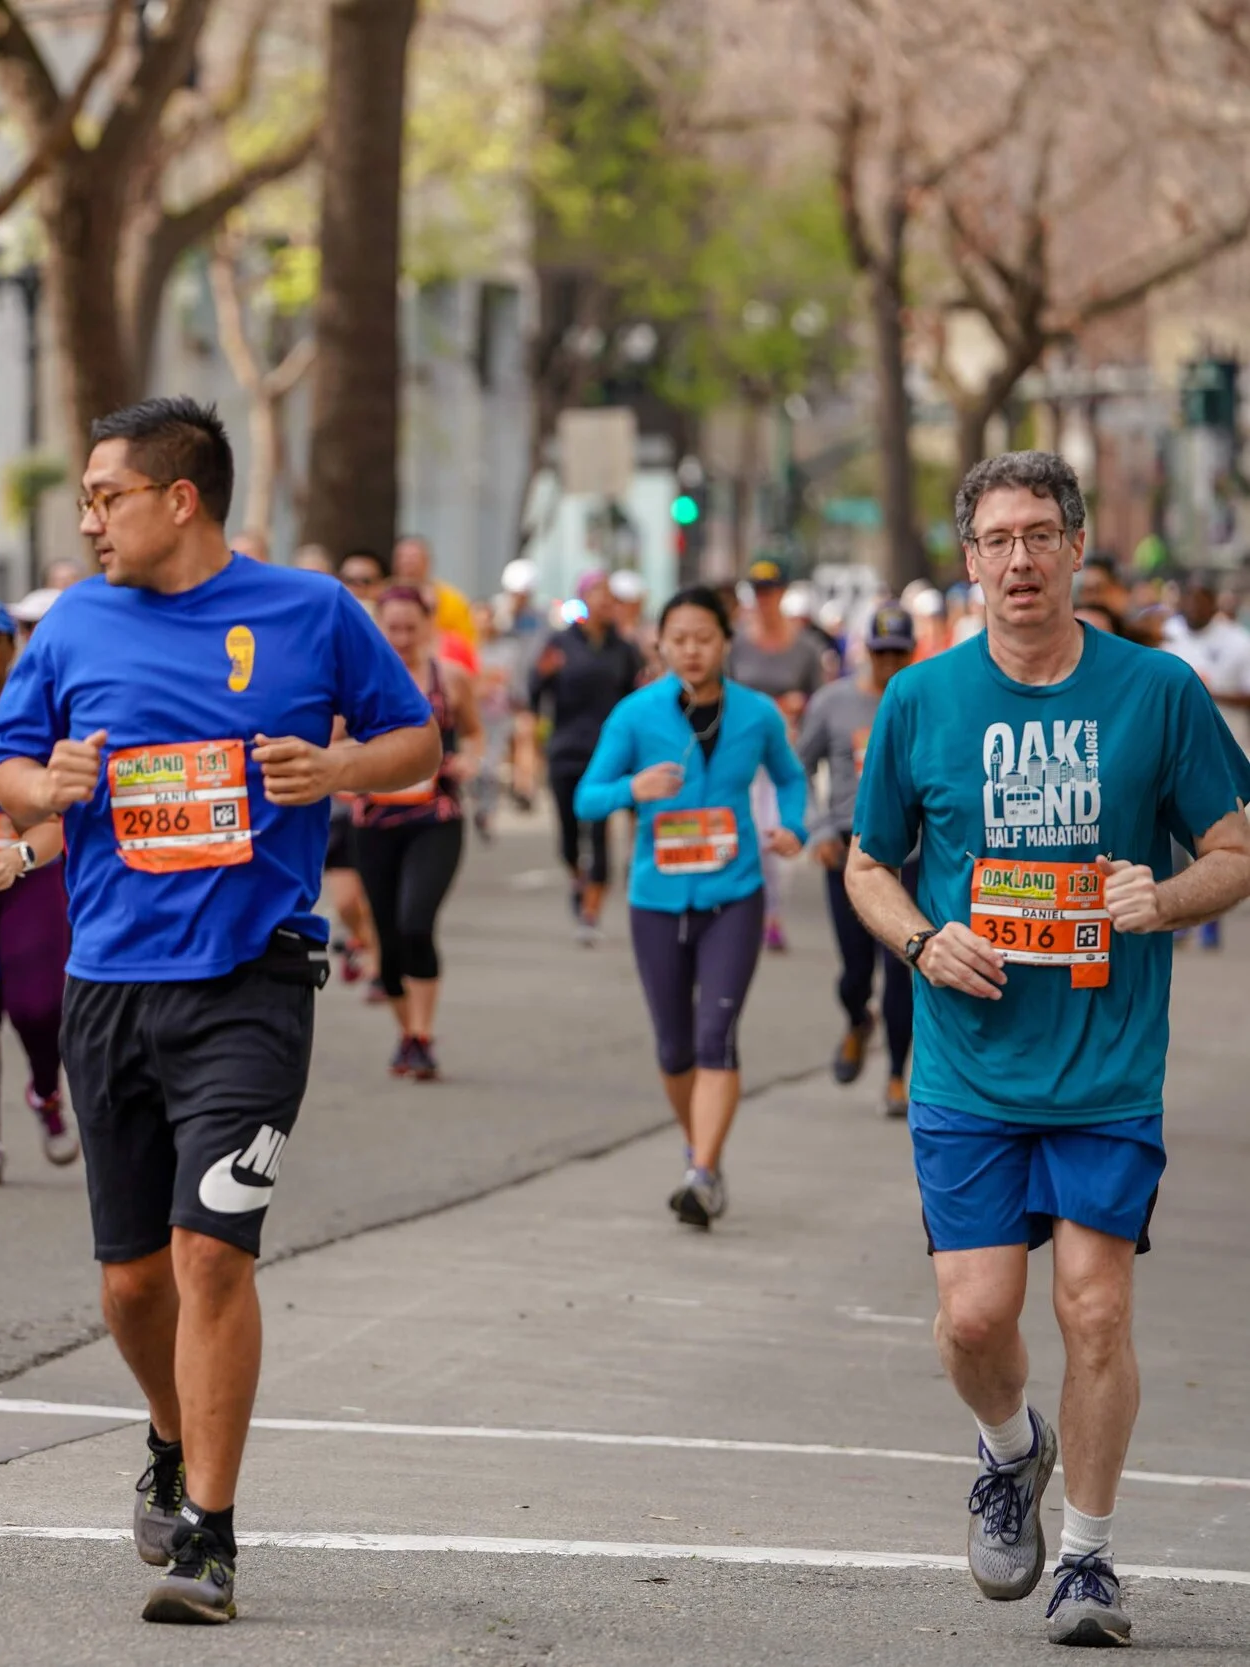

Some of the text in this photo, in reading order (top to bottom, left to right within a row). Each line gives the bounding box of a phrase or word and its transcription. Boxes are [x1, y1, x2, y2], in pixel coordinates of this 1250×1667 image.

[196, 751, 228, 772] 13.1
[983, 719, 1084, 779] OAK
[116, 751, 185, 778] OAKLAND
[155, 791, 199, 804] DANIEL
[983, 779, 1102, 828] LND
[123, 806, 191, 836] 2986
[984, 824, 1101, 849] HALF MARATHON
[983, 866, 1055, 890] OAKLAND
[1069, 875, 1099, 893] 13.1
[1022, 908, 1066, 920] DANIEL
[981, 918, 1056, 950] 3516
